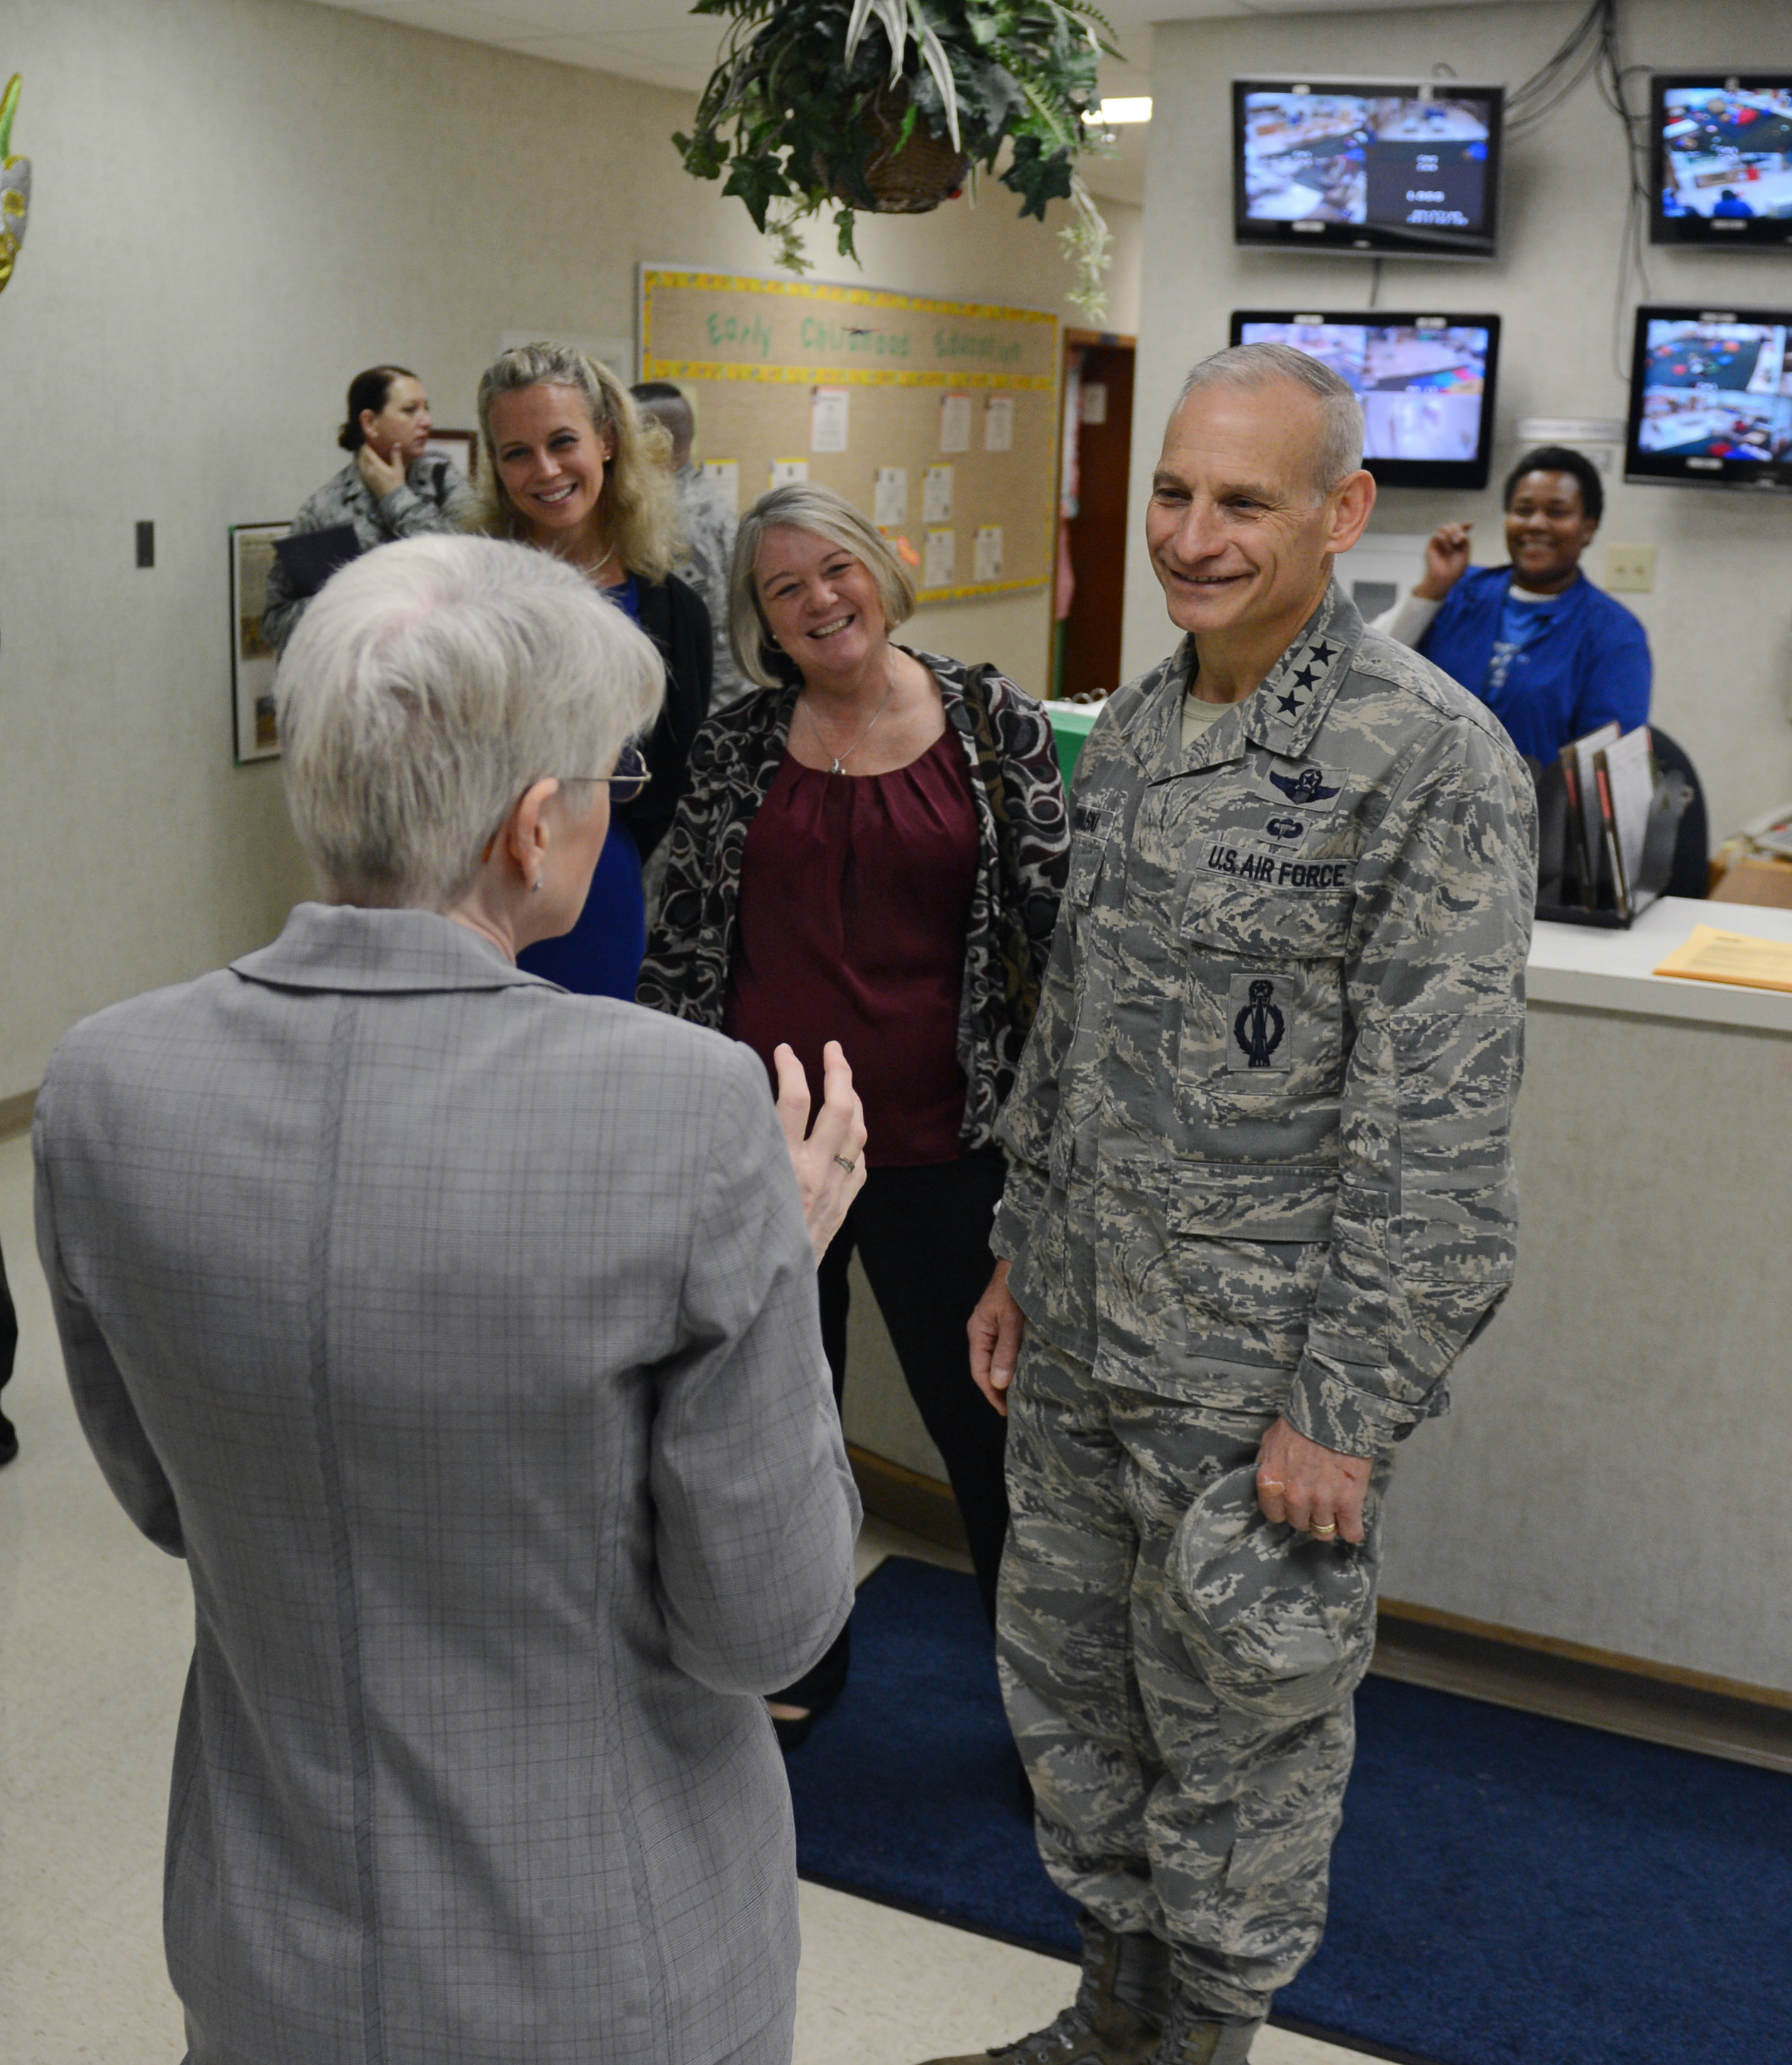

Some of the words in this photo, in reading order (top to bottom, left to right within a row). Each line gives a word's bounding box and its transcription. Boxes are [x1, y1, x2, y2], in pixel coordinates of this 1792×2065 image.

[706, 310, 773, 358] Early
[1239, 853, 1275, 882] AIR
[1278, 861, 1347, 887] FORCE
